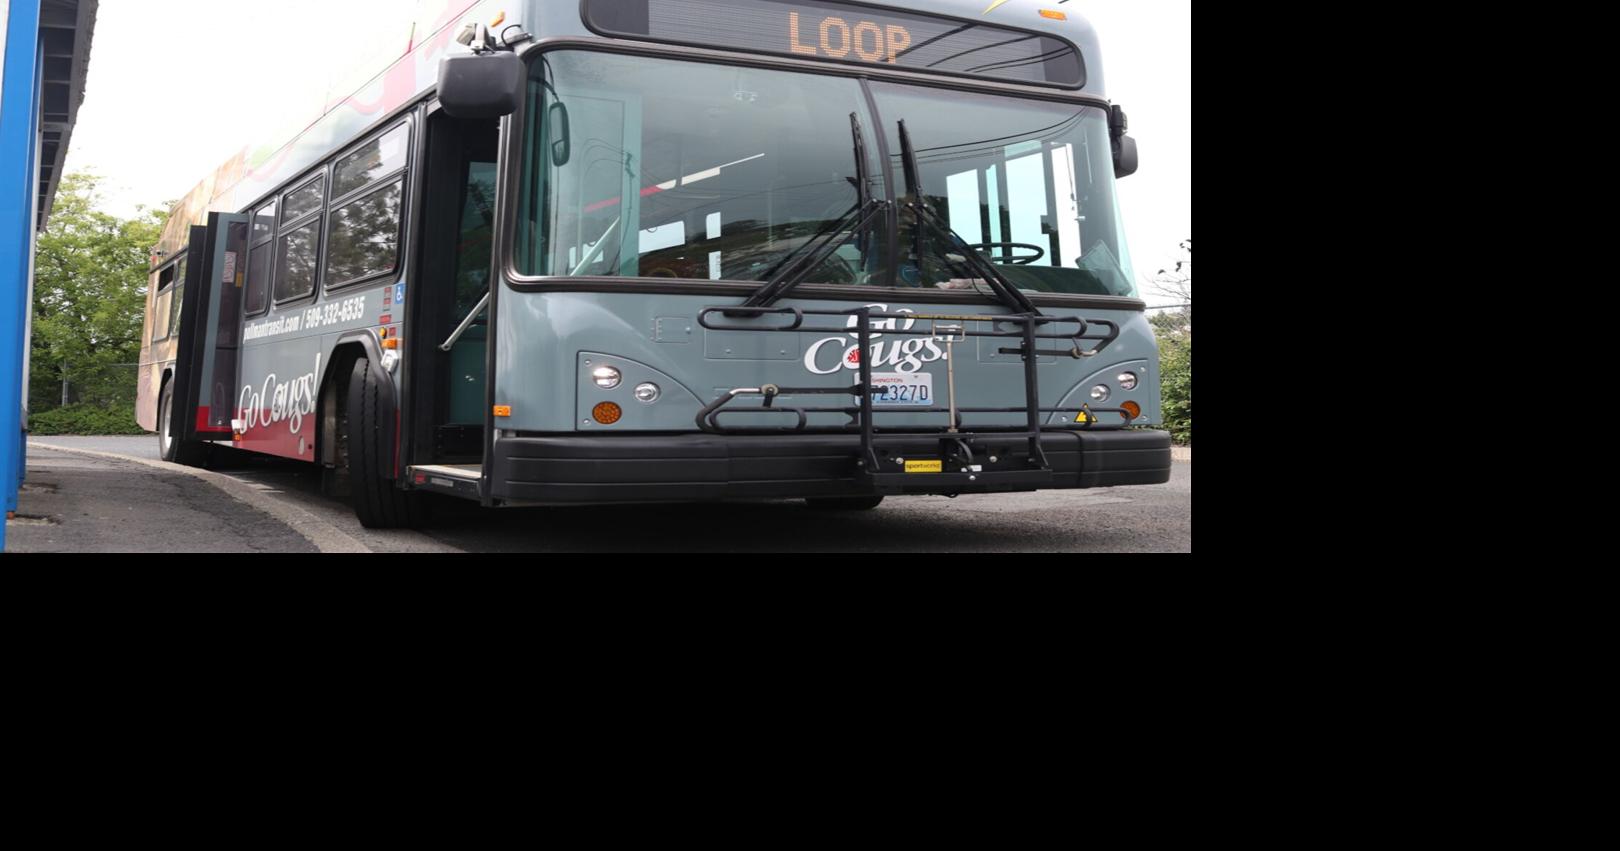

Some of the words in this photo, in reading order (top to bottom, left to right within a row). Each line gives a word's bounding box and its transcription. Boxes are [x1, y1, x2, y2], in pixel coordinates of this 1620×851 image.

[789, 11, 911, 64] LOOP
[305, 296, 367, 329] 509-332-6535
[846, 303, 915, 339] Go
[237, 384, 260, 435] Go
[260, 352, 321, 434] Cougs!
[871, 376, 904, 384] SHINGTON
